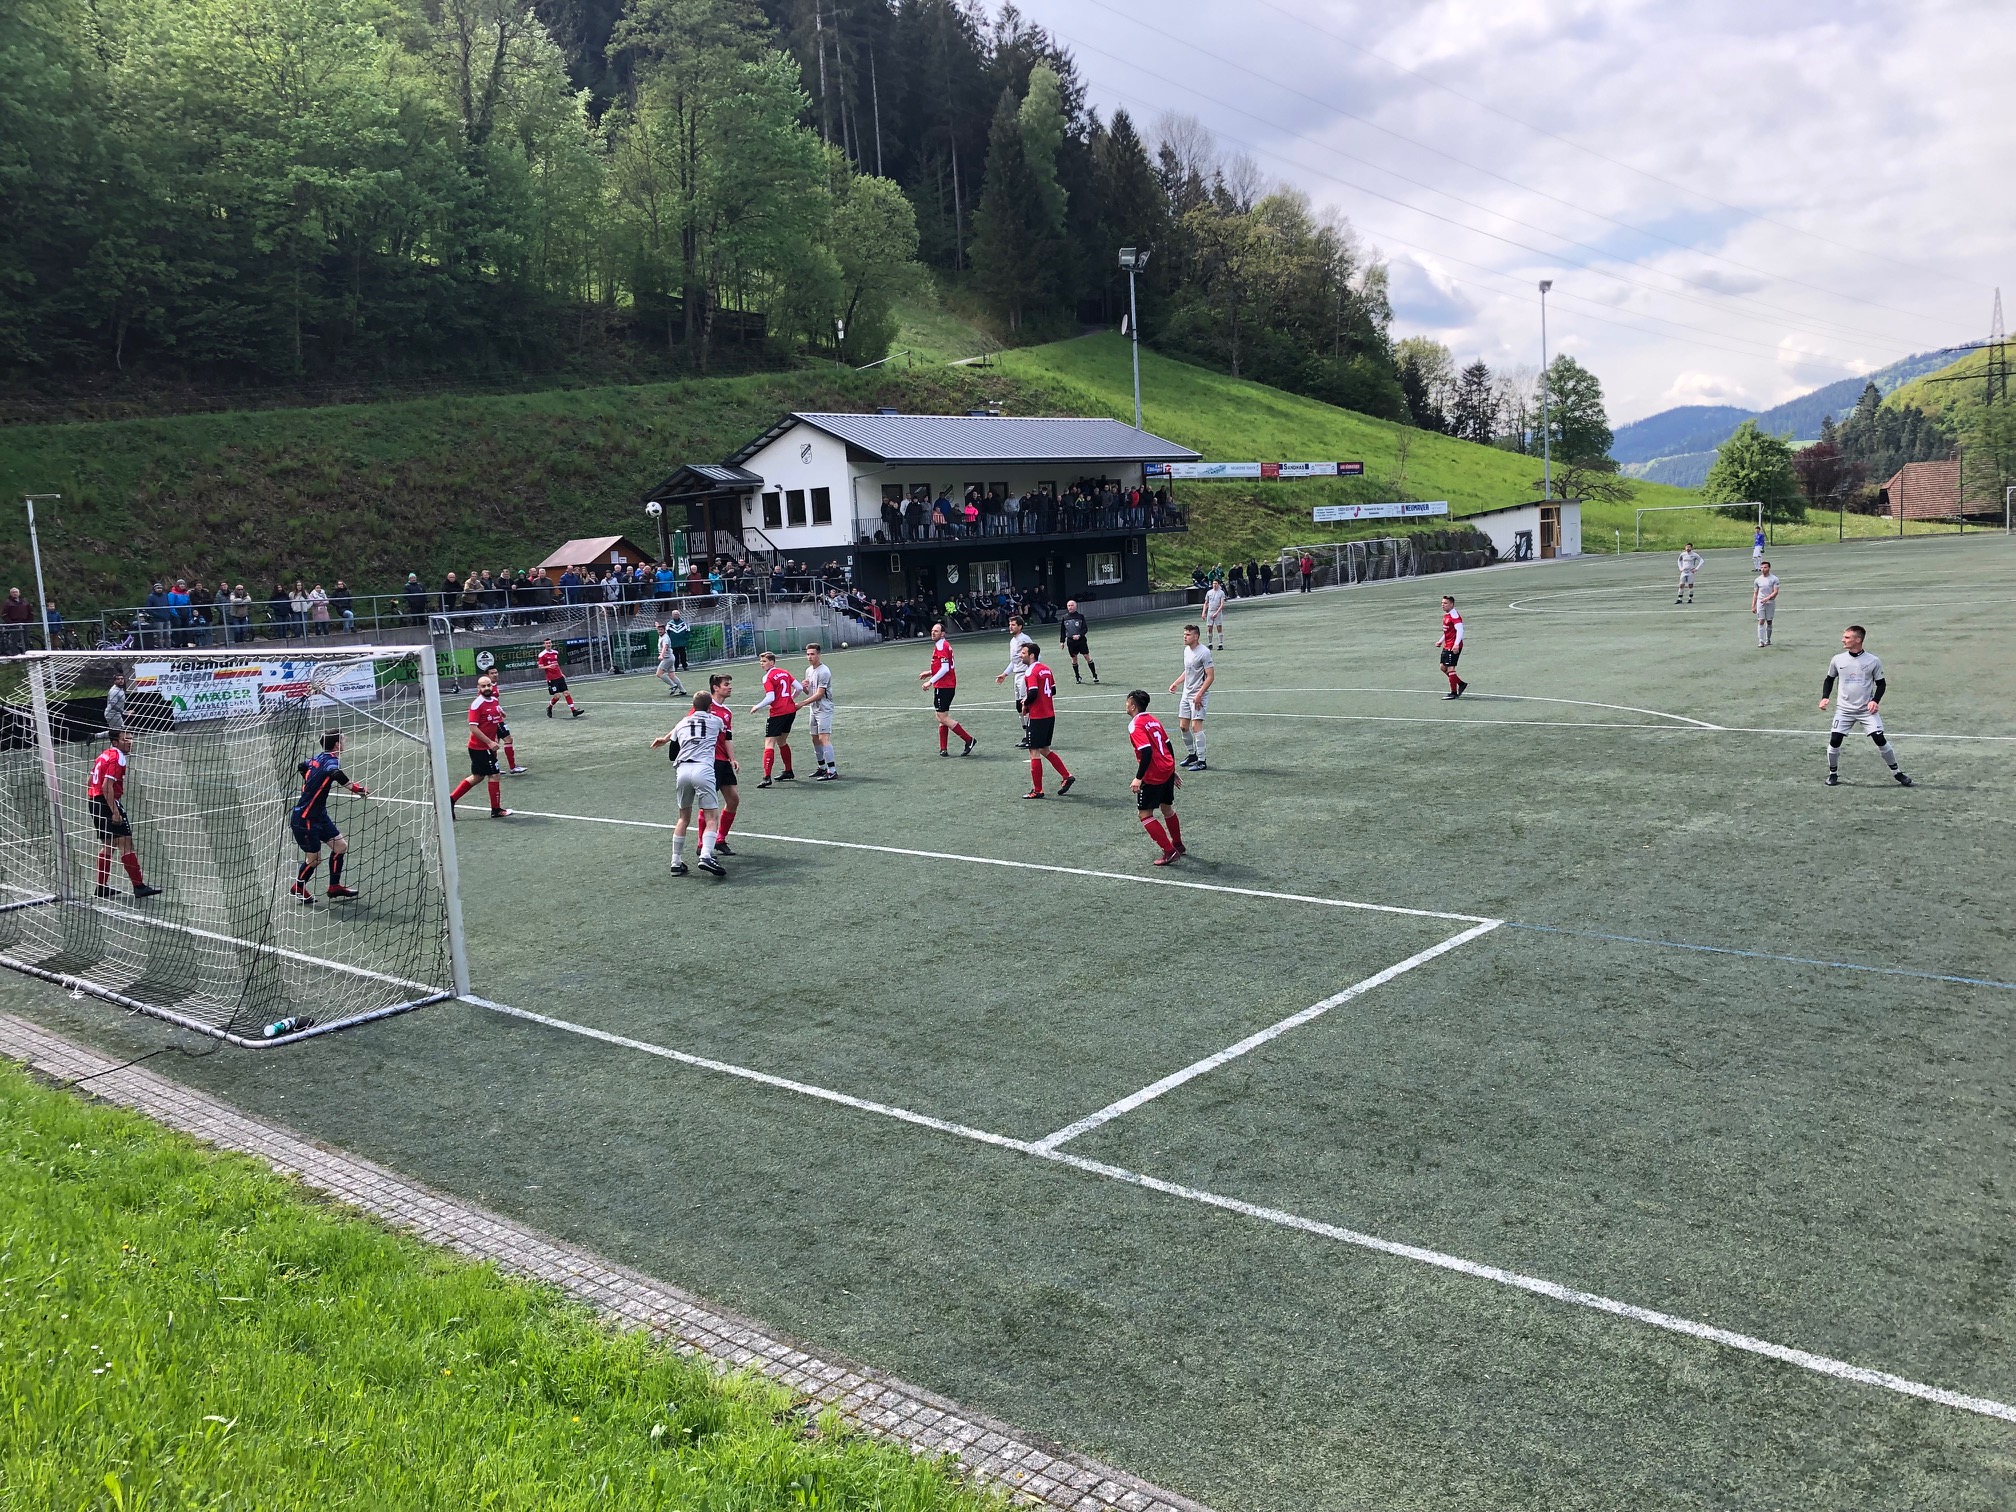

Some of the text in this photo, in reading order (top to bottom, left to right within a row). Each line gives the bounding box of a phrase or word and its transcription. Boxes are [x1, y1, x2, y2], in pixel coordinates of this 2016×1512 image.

[1101, 563, 1114, 573] 1956
[780, 679, 790, 697] 2
[1044, 677, 1052, 698] 4
[688, 718, 707, 737] 11
